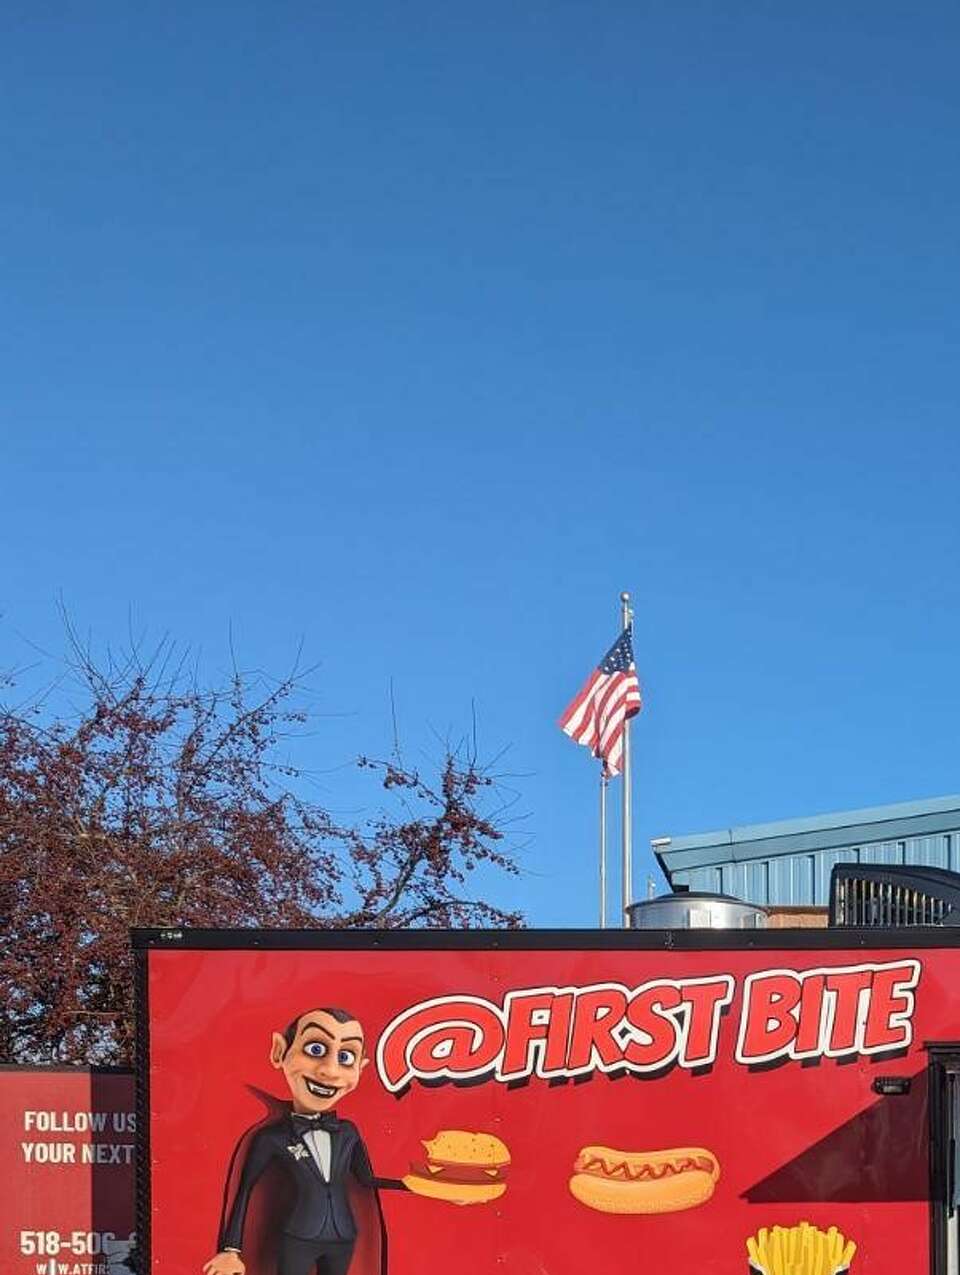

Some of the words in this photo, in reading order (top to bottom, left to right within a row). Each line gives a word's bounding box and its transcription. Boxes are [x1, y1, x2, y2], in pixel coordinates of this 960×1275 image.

[377, 973, 736, 1094] @FIRST
[735, 960, 922, 1064] BITE
[24, 1111, 107, 1132] FOLLOW
[112, 1112, 137, 1132] US
[21, 1142, 76, 1164] YOUR
[81, 1144, 135, 1164] NEXT
